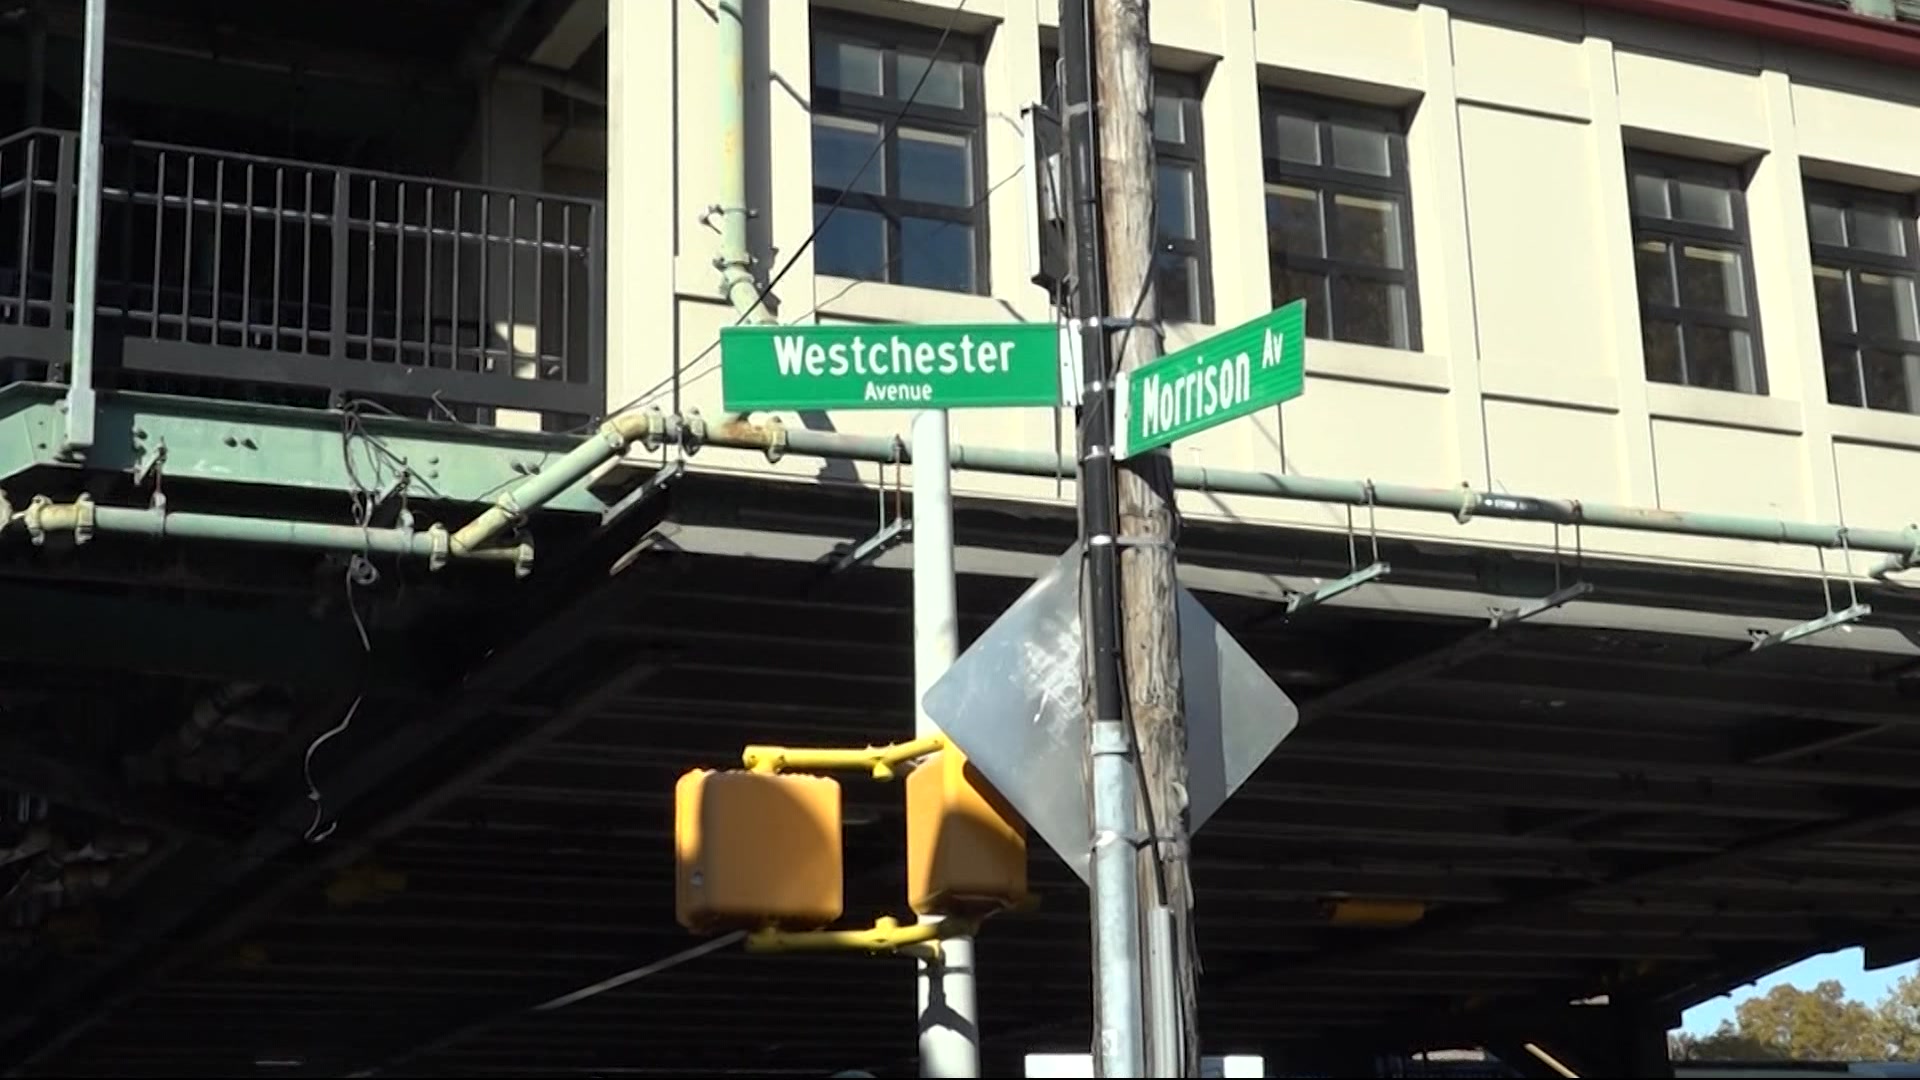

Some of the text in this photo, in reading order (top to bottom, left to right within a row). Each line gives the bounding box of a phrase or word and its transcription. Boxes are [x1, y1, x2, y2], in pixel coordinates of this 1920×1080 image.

[773, 334, 1015, 376] Westchester
[864, 381, 933, 401] Avenue
[1142, 328, 1284, 438] Morrison Av
